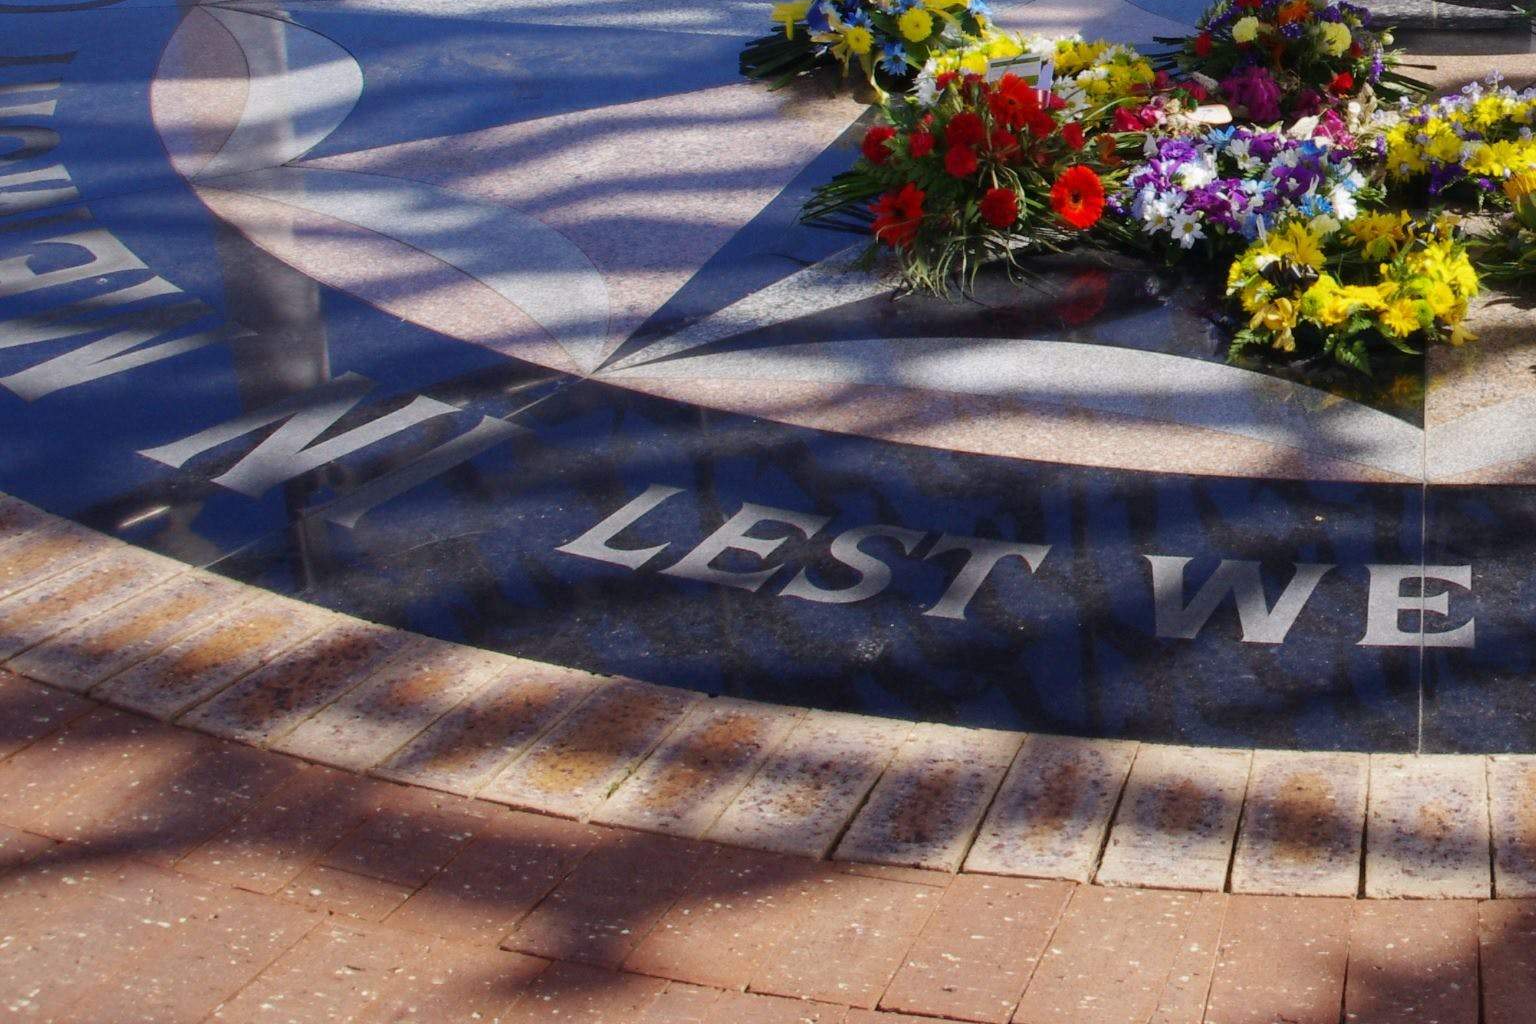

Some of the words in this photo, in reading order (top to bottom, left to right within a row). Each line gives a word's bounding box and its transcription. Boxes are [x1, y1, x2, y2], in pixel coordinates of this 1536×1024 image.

[136, 372, 535, 529] IN
[555, 483, 1052, 620] LEST
[1142, 554, 1478, 649] WE
